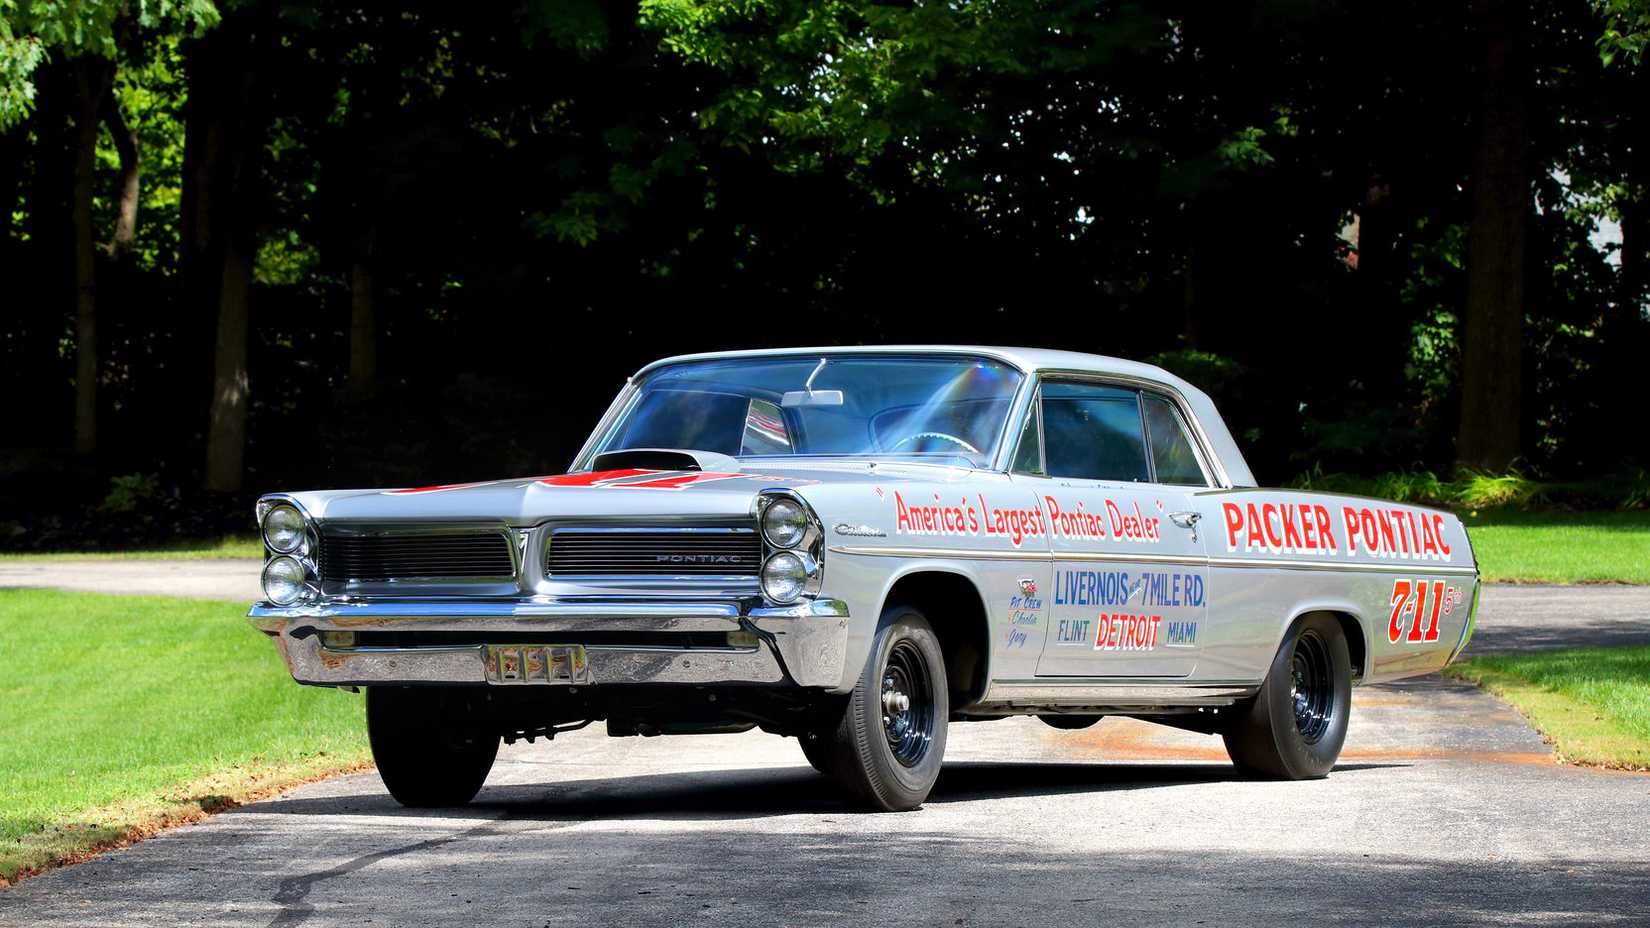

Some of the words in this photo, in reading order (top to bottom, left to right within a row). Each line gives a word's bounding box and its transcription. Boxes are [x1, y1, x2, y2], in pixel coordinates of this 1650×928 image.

[977, 492, 1046, 548] Largest
[1043, 495, 1106, 539] Pontiac
[1222, 502, 1338, 556] PACKER
[1341, 505, 1452, 562] PONTIAC
[656, 554, 741, 563] PONTIAC
[1055, 570, 1129, 606] LIVERNOIS
[1184, 574, 1206, 608] RD.
[1388, 578, 1446, 644] 7-11
[1058, 619, 1090, 641] FLINT
[1094, 613, 1162, 651] DETROIT
[1167, 622, 1197, 643] MIAMI
